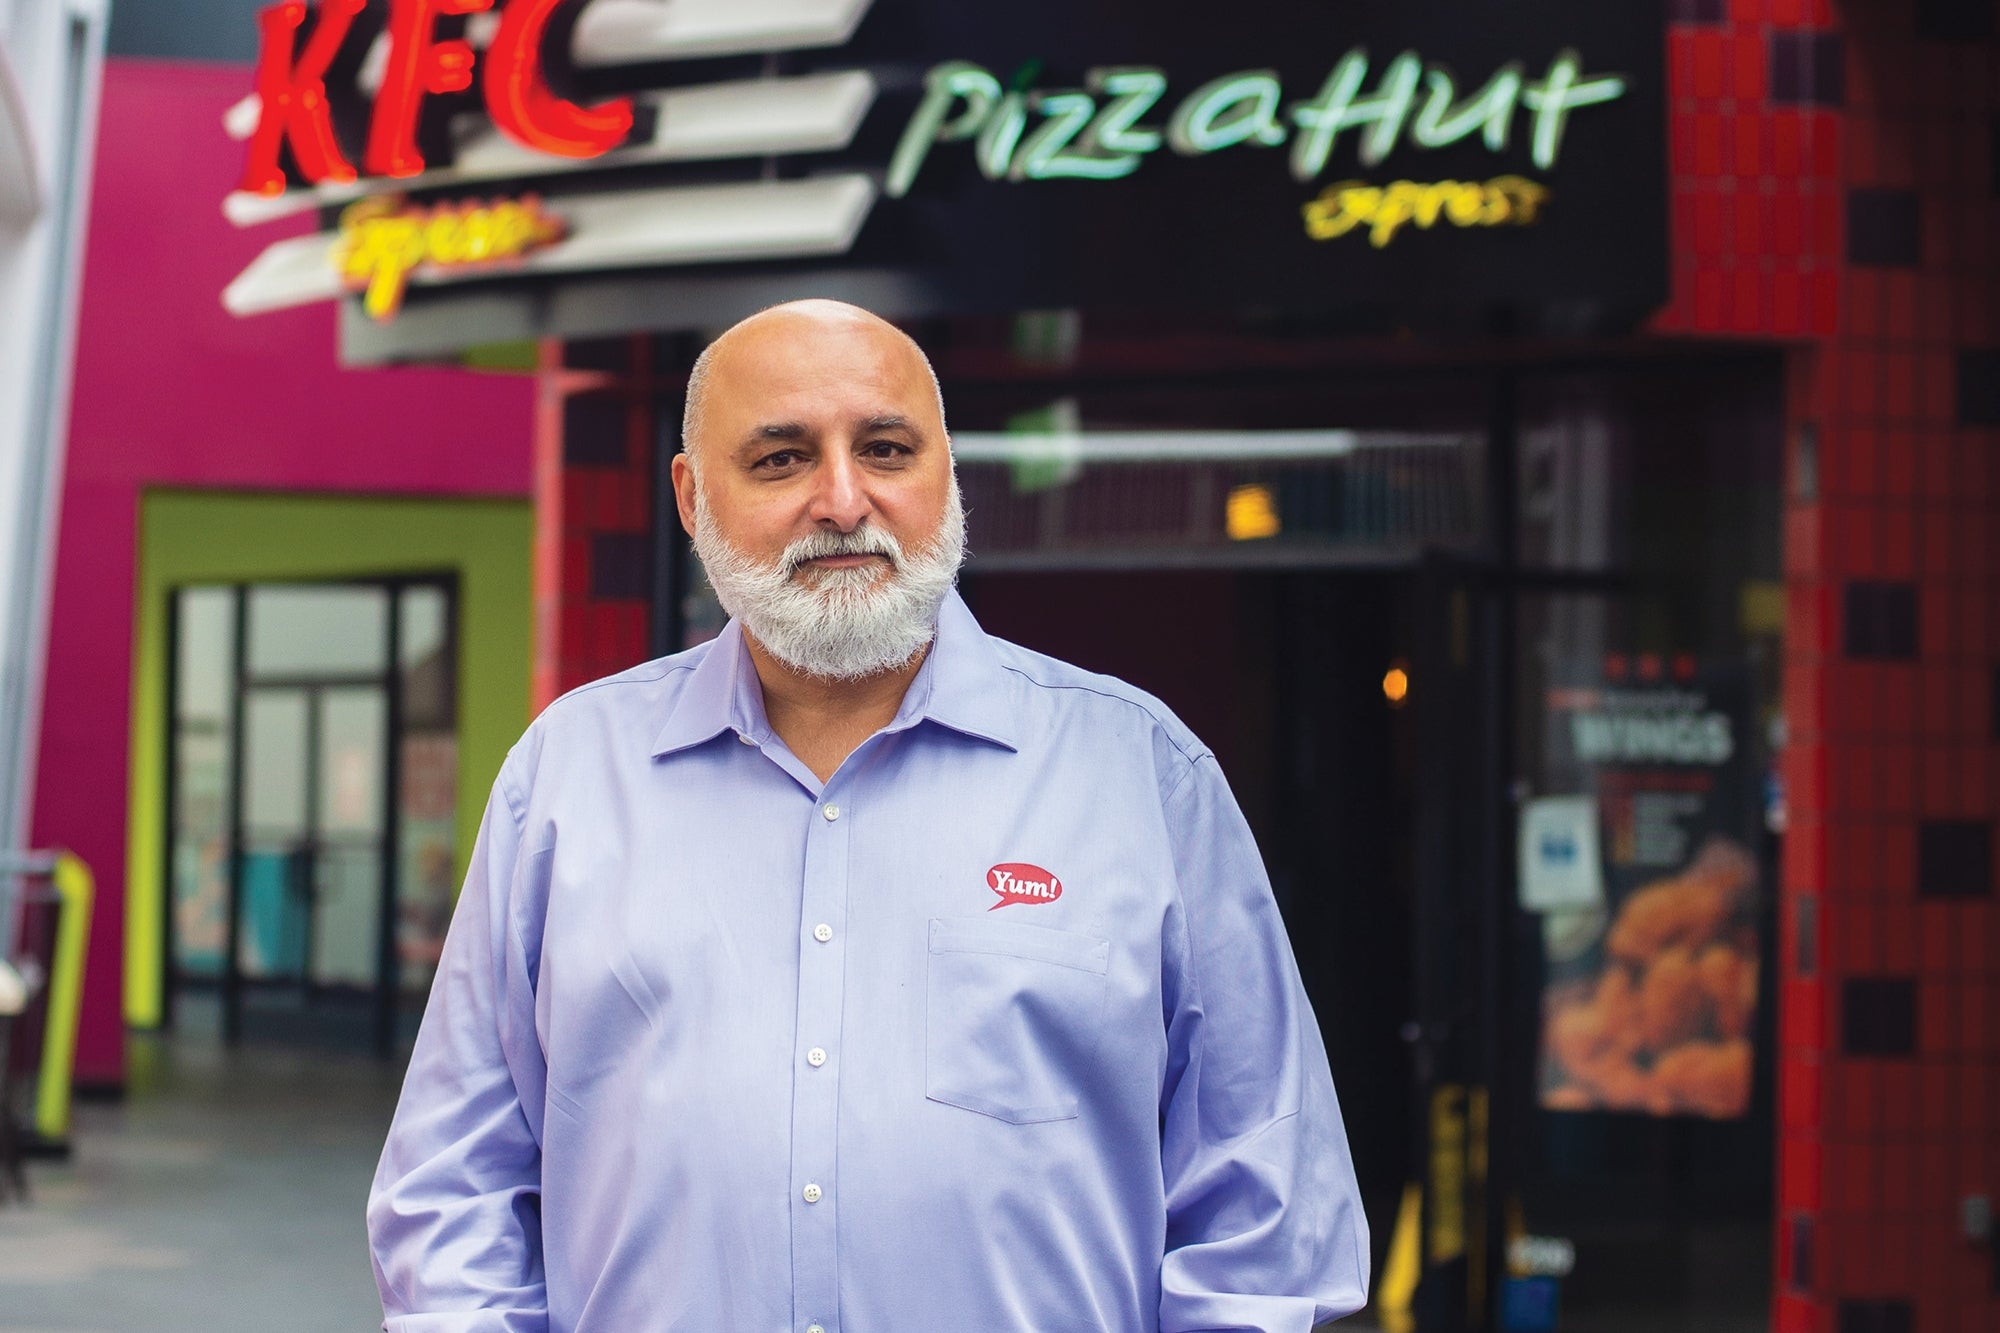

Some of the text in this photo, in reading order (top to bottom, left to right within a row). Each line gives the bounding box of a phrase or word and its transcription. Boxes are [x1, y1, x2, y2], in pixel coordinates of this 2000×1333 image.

[243, 0, 634, 198] KFC
[884, 45, 1625, 198] Pizza Hut
[1572, 713, 1731, 764] WINGS
[991, 869, 1058, 898] Yum!
